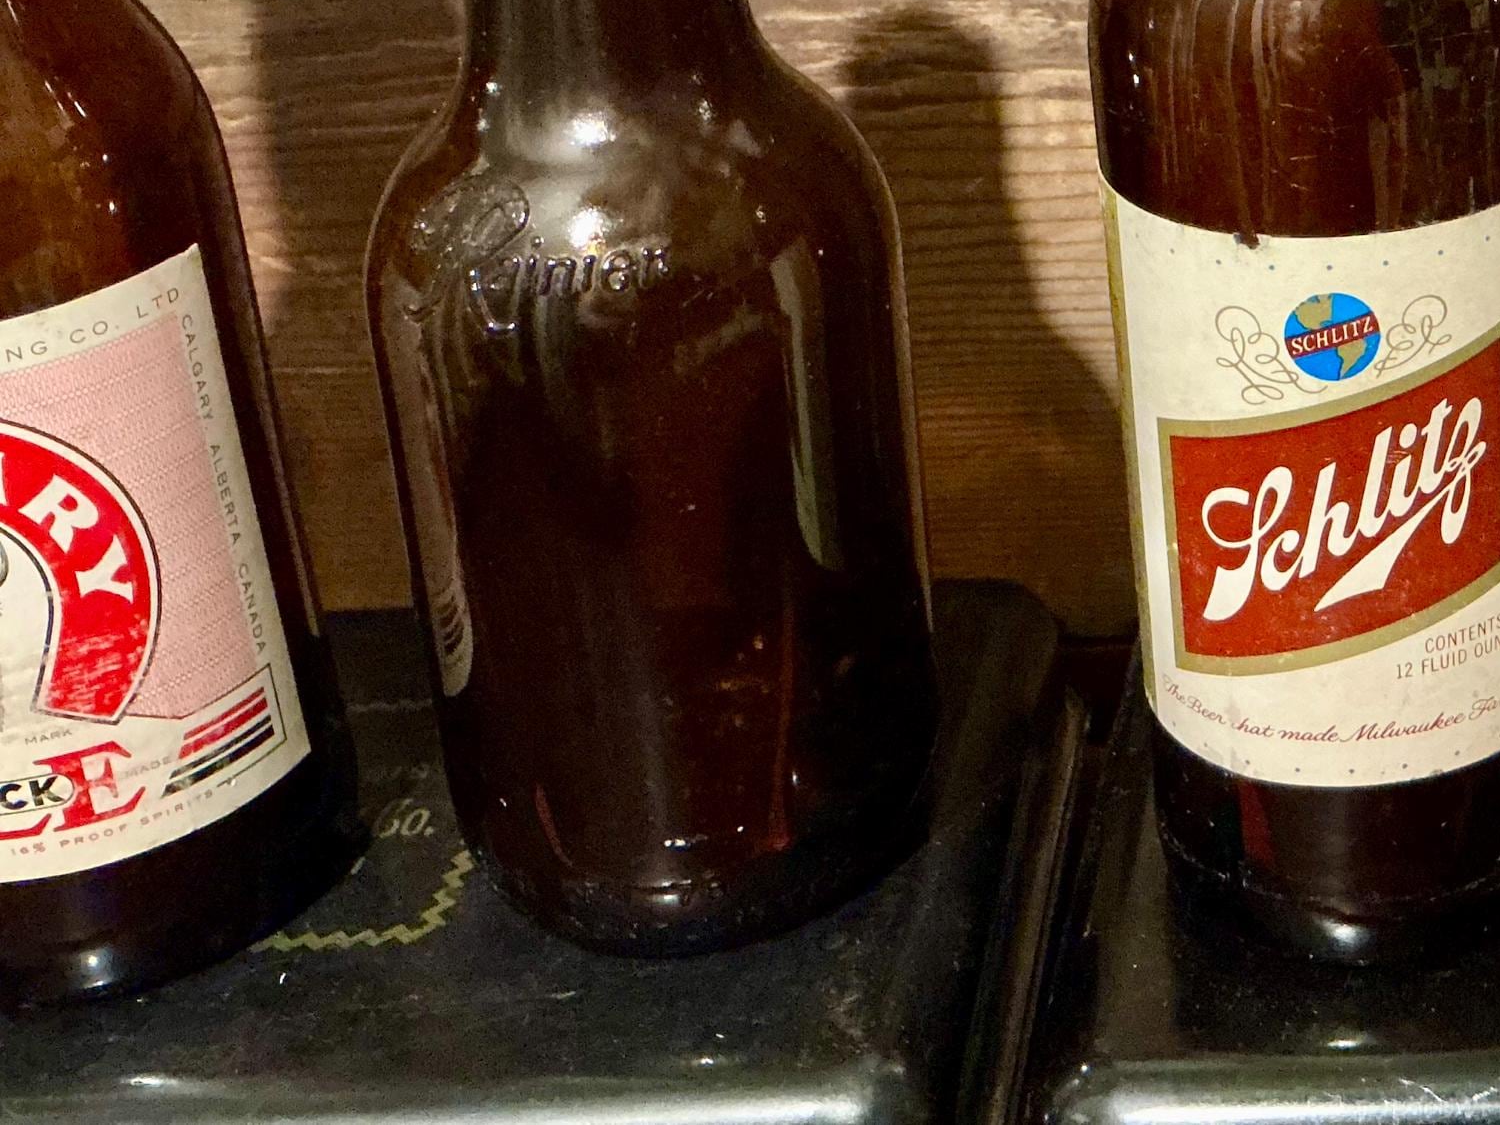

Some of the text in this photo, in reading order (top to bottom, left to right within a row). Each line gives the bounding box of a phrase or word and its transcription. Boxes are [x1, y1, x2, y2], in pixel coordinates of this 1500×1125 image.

[69, 320, 120, 345] CO.
[136, 286, 180, 319] LTD
[1291, 315, 1375, 356] SCHLITZ
[1200, 396, 1488, 621] Schlitz
[238, 562, 267, 656] CANADA
[1395, 663, 1413, 680] 12
[1421, 649, 1468, 676] FLUID
[24, 728, 73, 746] MARK
[1161, 674, 1187, 705] The
[1185, 694, 1228, 725] Beer
[1231, 717, 1276, 738] hat
[1277, 724, 1340, 743] made
[1339, 711, 1468, 743] Milwaukee
[59, 822, 130, 850] PROOF
[139, 789, 214, 826] SPIRITS
